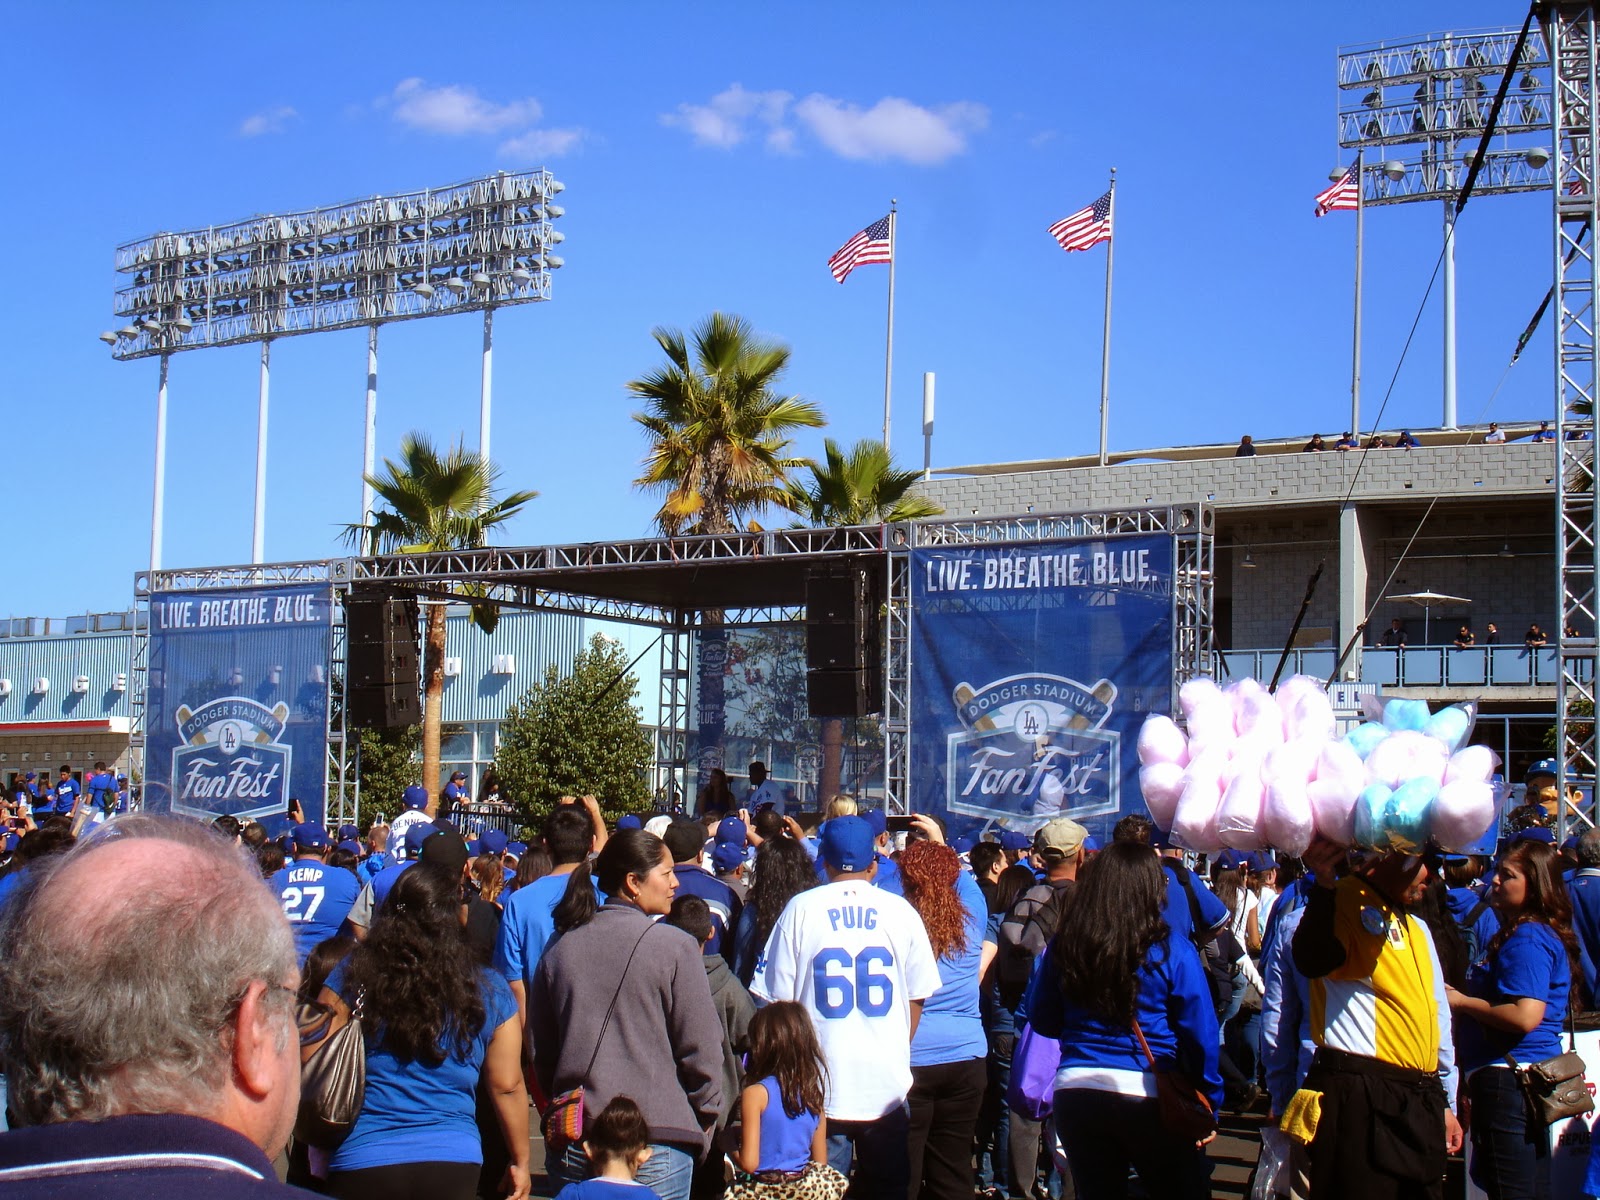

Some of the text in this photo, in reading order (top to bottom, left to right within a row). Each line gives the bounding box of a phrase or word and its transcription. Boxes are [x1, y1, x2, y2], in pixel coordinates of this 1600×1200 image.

[927, 550, 1158, 592] LIVE. BREATHE. BLUE.
[161, 594, 320, 629] LIVE. BREATHE. BLUE.
[968, 684, 1096, 718] DODGER STADIUM
[187, 705, 275, 733] DODGER STADIUM
[1023, 711, 1039, 735] LA
[225, 727, 236, 749] LA
[181, 757, 280, 799] FanFest
[961, 746, 1104, 796] FanFest
[288, 867, 323, 883] KEMP
[281, 886, 325, 921] 27
[827, 905, 878, 931] PUIG
[812, 946, 894, 1019] 66
